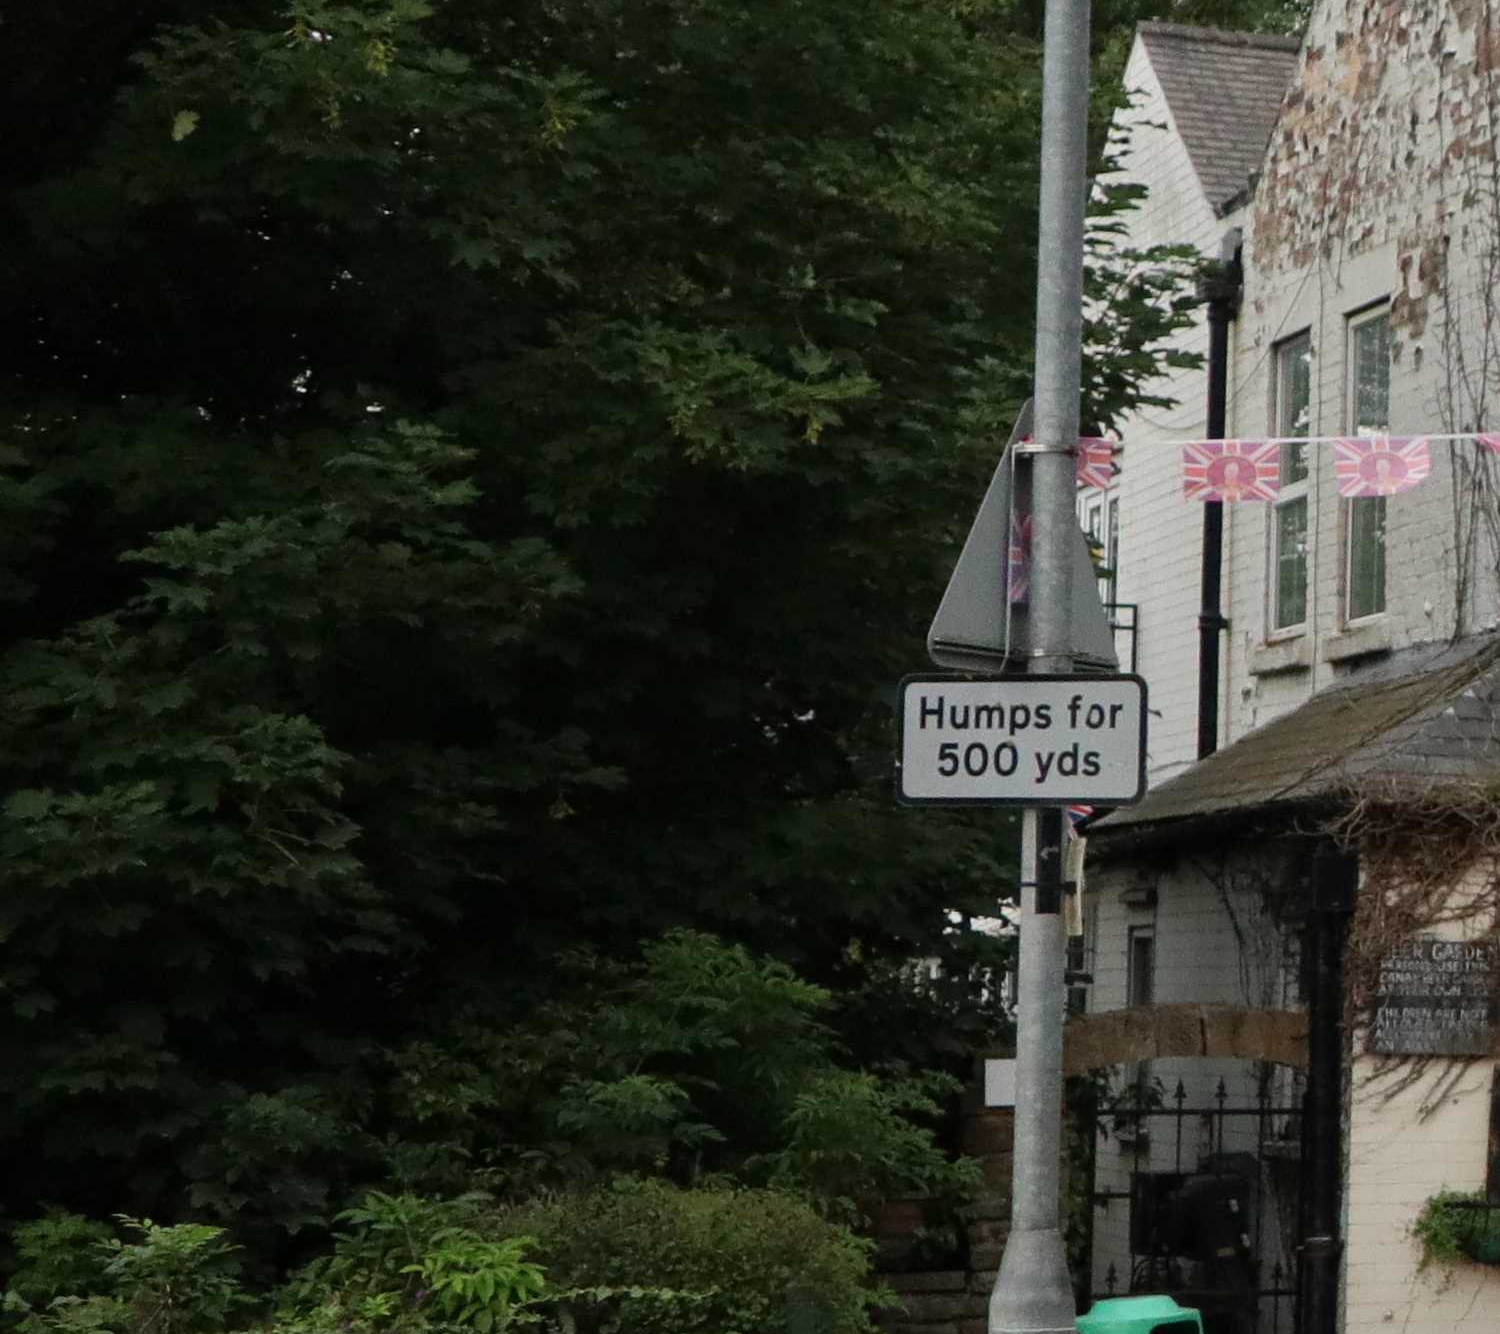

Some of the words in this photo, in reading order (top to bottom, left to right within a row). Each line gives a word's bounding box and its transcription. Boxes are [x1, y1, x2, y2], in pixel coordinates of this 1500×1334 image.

[919, 696, 1052, 736] Humps
[1067, 694, 1124, 729] for
[937, 742, 1019, 777] 500
[1034, 742, 1102, 785] yds
